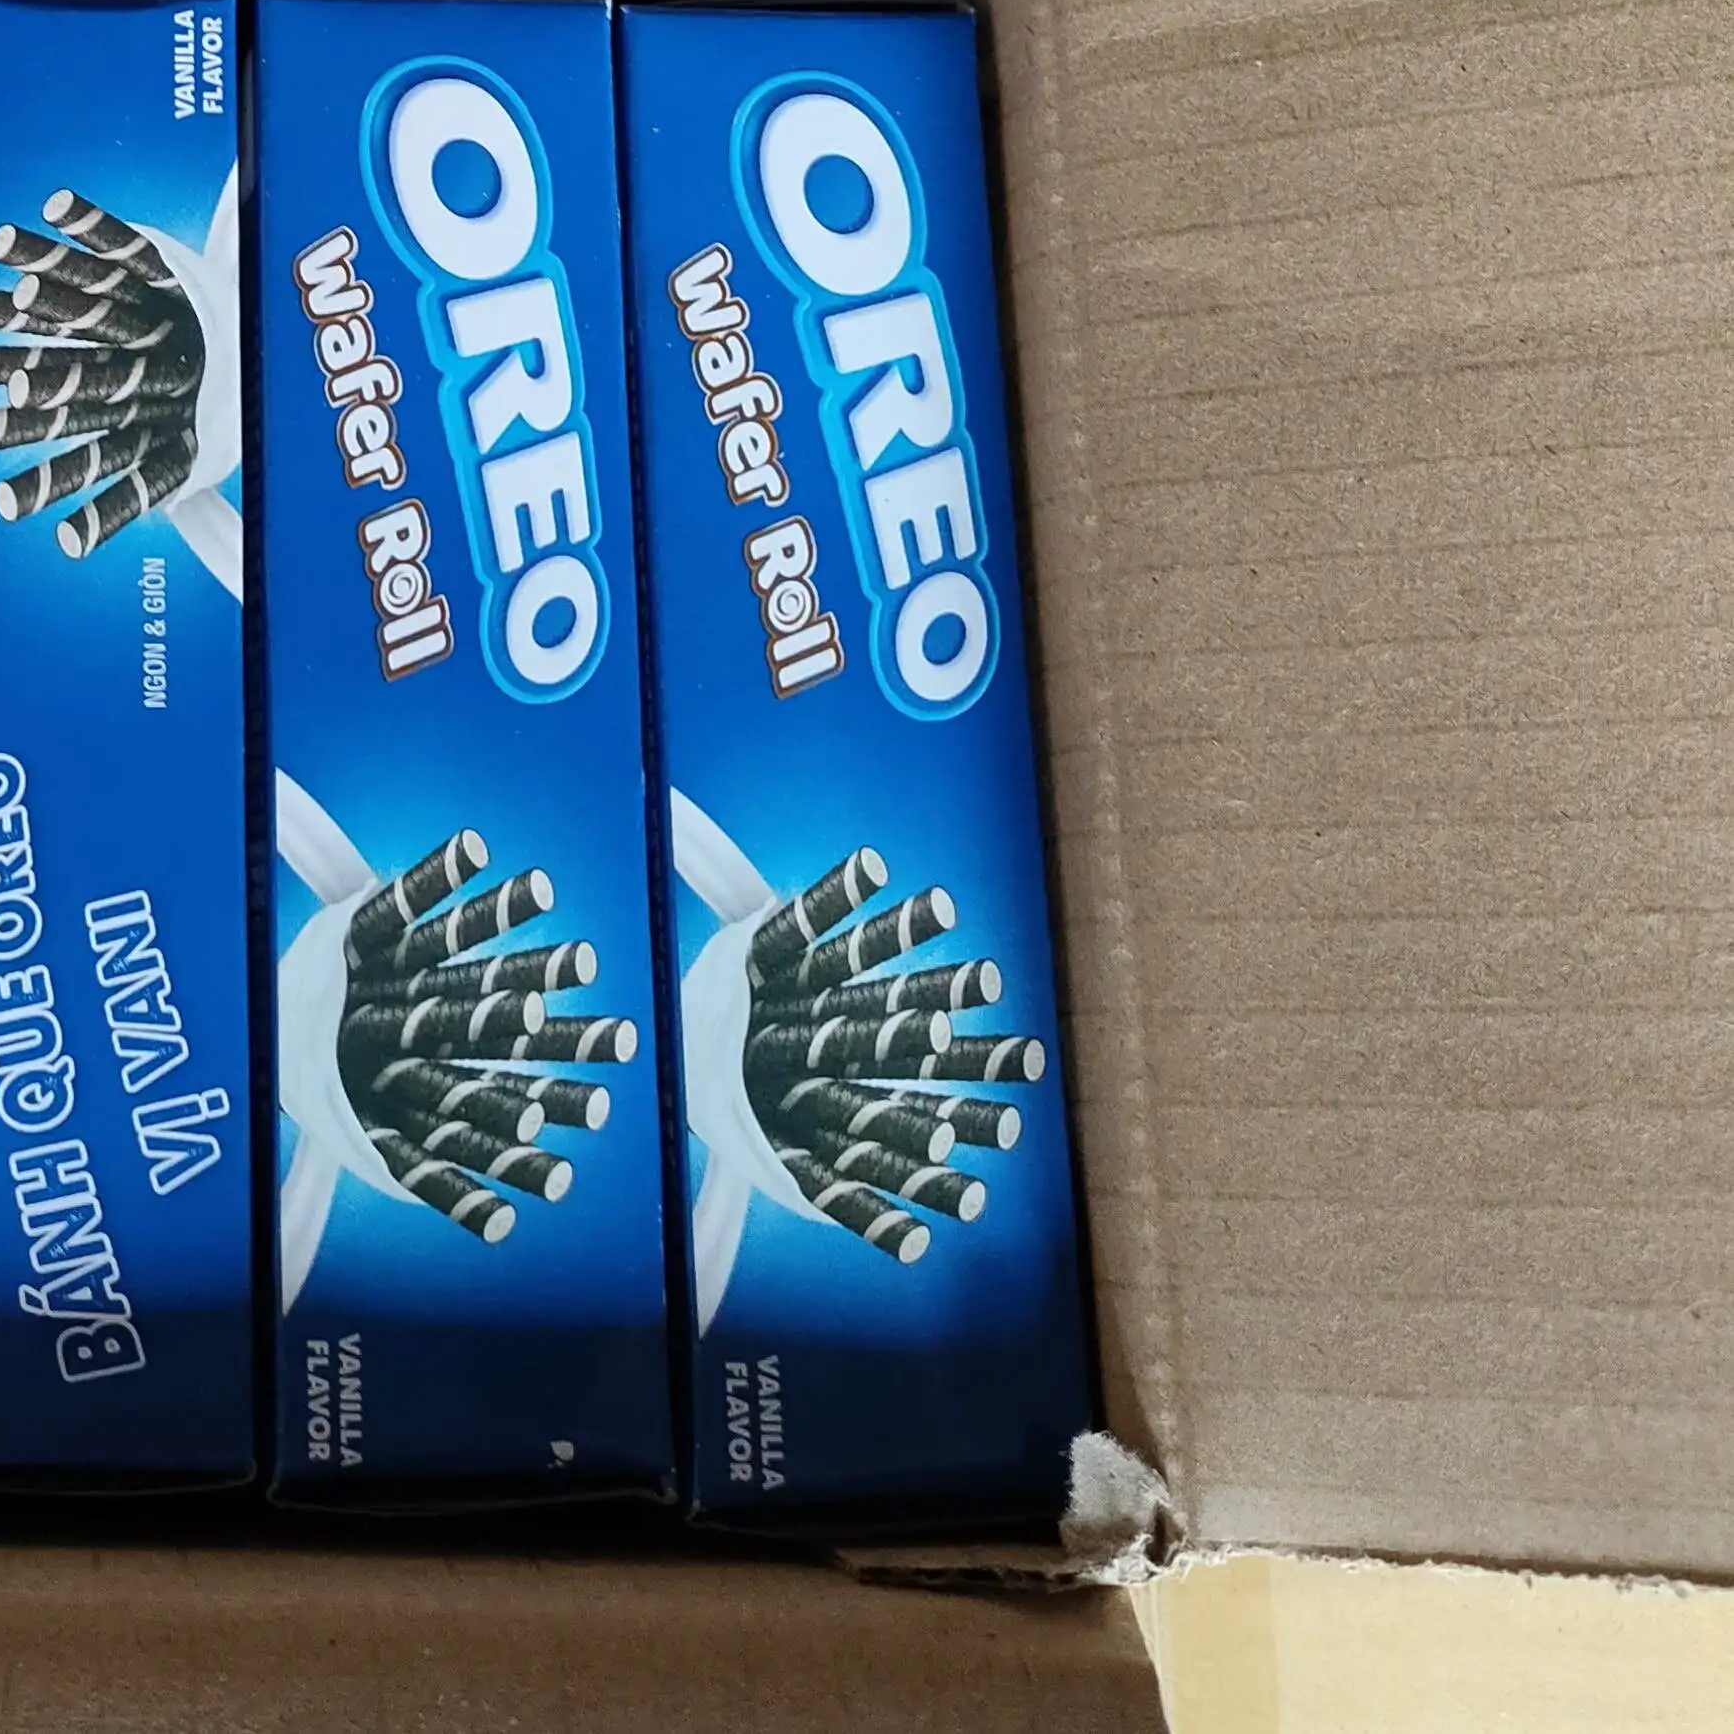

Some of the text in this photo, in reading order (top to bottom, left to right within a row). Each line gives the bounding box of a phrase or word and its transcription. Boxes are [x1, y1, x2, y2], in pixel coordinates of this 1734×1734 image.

[173, 9, 196, 120] VANILLA
[201, 17, 224, 114] FLAVOR
[387, 75, 601, 687] OREO
[757, 91, 991, 704] OREO
[294, 225, 455, 682] Wafer Roll
[668, 241, 846, 700] Wafer Roll
[142, 618, 167, 638] &
[142, 642, 167, 709] NGON
[84, 889, 231, 1197] VỊ VANI
[8, 1139, 146, 1383] BÁNH
[306, 1339, 332, 1461] FLAVOR
[338, 1332, 364, 1468] VANILLA
[725, 1361, 753, 1482] FLAVOR
[756, 1354, 786, 1492] VANILLA
